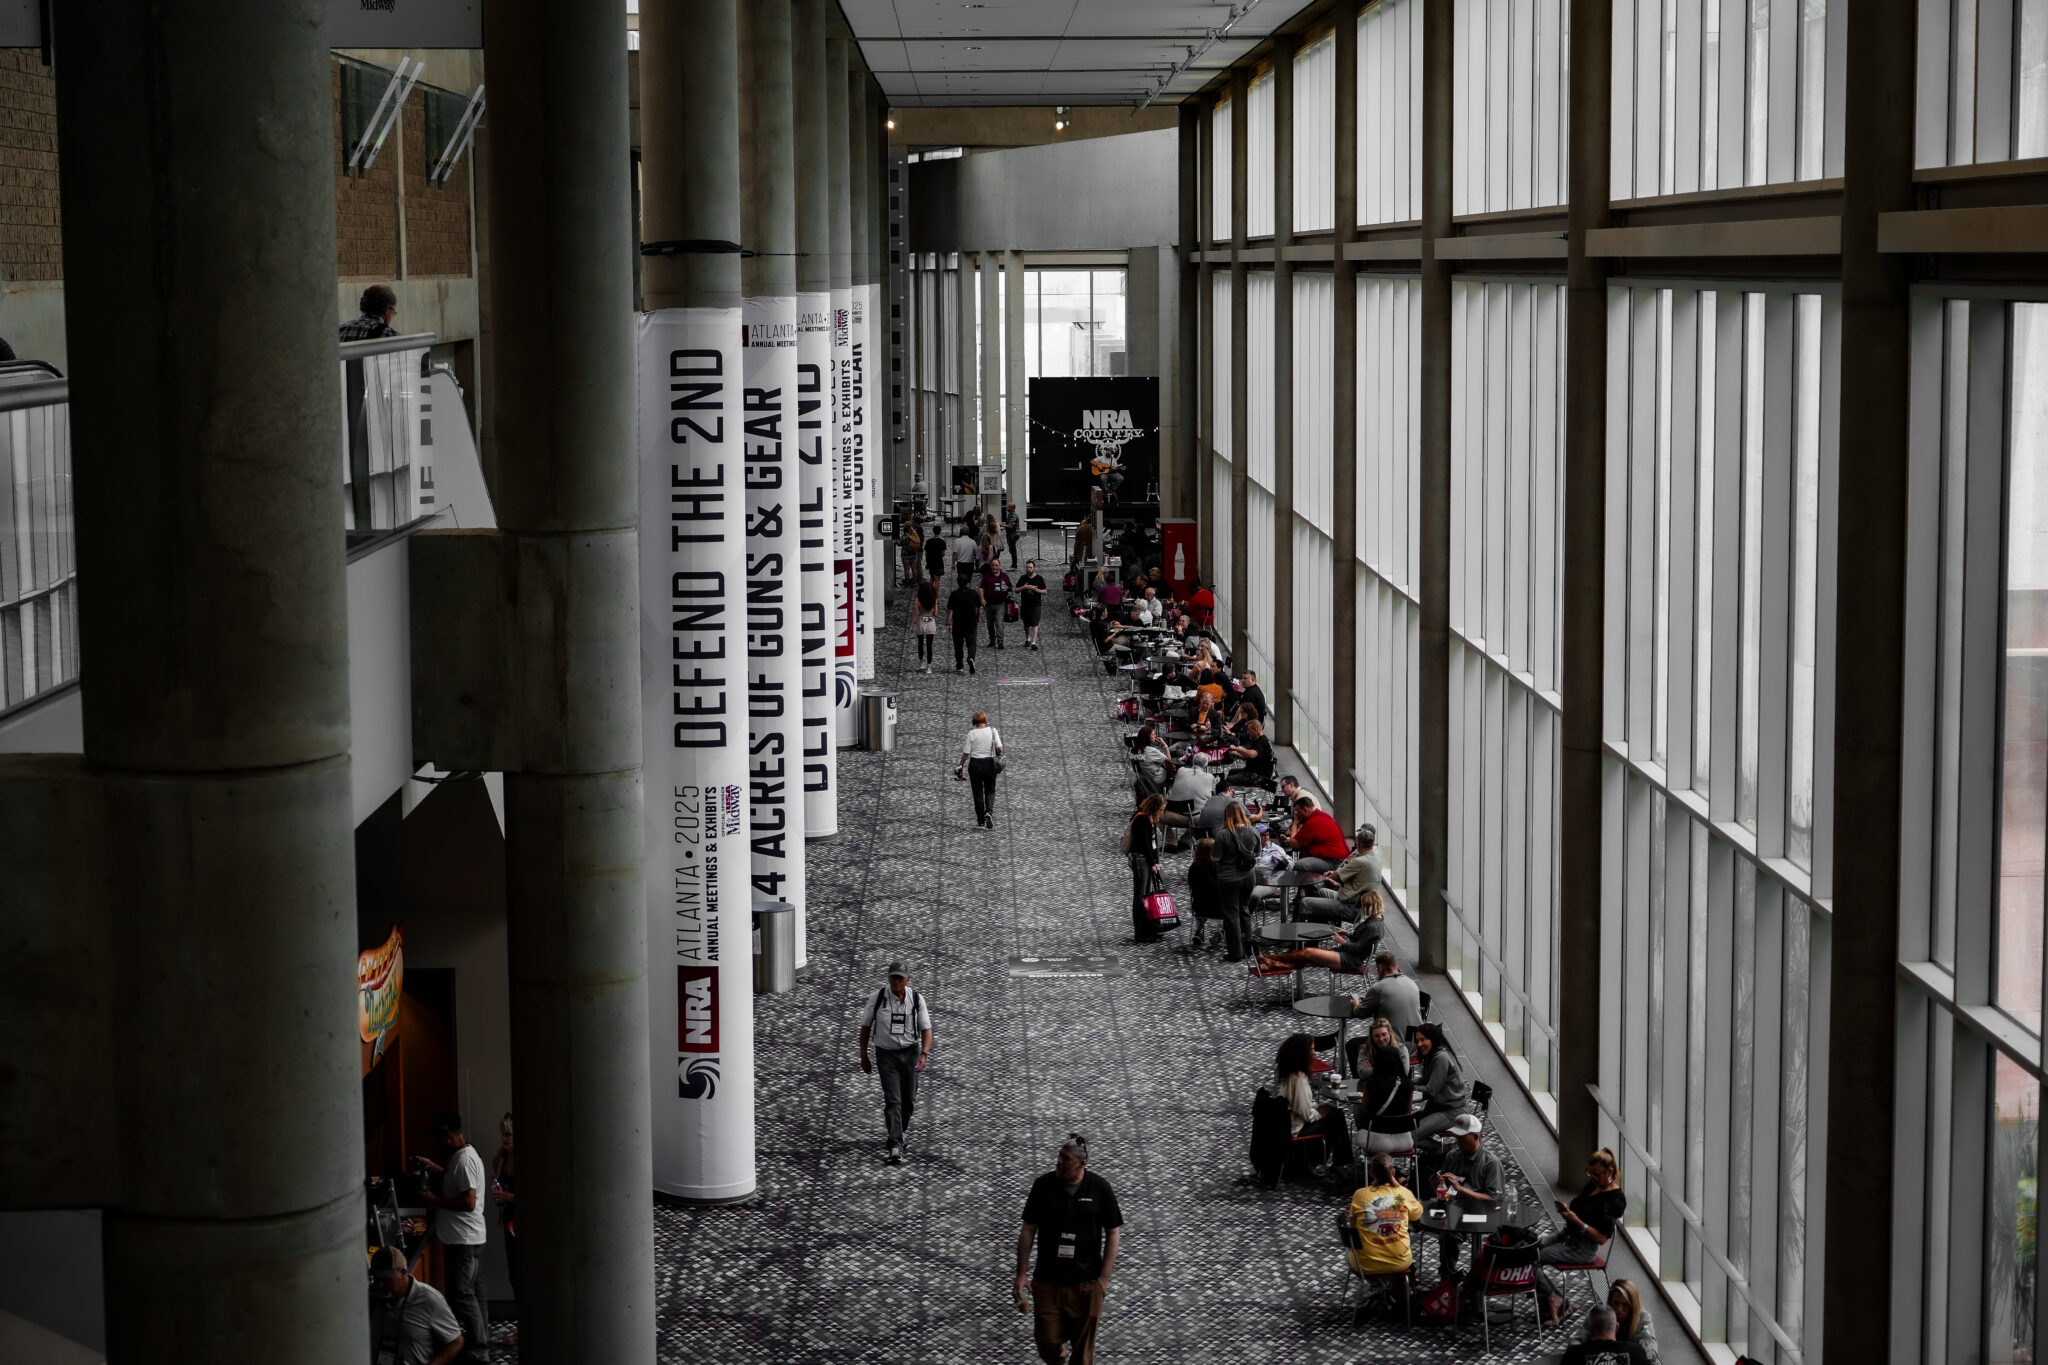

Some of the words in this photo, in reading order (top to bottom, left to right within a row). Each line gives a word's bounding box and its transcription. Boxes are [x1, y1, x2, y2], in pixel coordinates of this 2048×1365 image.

[751, 340, 776, 348] ANNUAL
[838, 308, 850, 347] Midway
[670, 349, 724, 444] 2ND
[841, 359, 851, 417] EXHIBITS
[743, 387, 783, 490] GEAR
[842, 422, 852, 432] &
[1073, 428, 1144, 439] COUNTRY
[1083, 409, 1134, 429] NRA
[842, 437, 852, 500] MEETINGS
[671, 463, 725, 552] THE
[745, 503, 783, 537] &
[843, 503, 853, 553] ANNUAL
[746, 553, 784, 657] GUNS
[672, 571, 727, 748] DEFEND
[674, 785, 700, 844] 2025
[704, 786, 718, 839] EXHIBITS
[726, 784, 742, 836] Midway
[749, 732, 786, 859] ACRES
[705, 842, 718, 852] &
[705, 856, 719, 912] MEETINGS
[675, 865, 701, 961] ATLANTA
[707, 916, 720, 961] ANNUAL
[685, 976, 712, 1045] NRA
